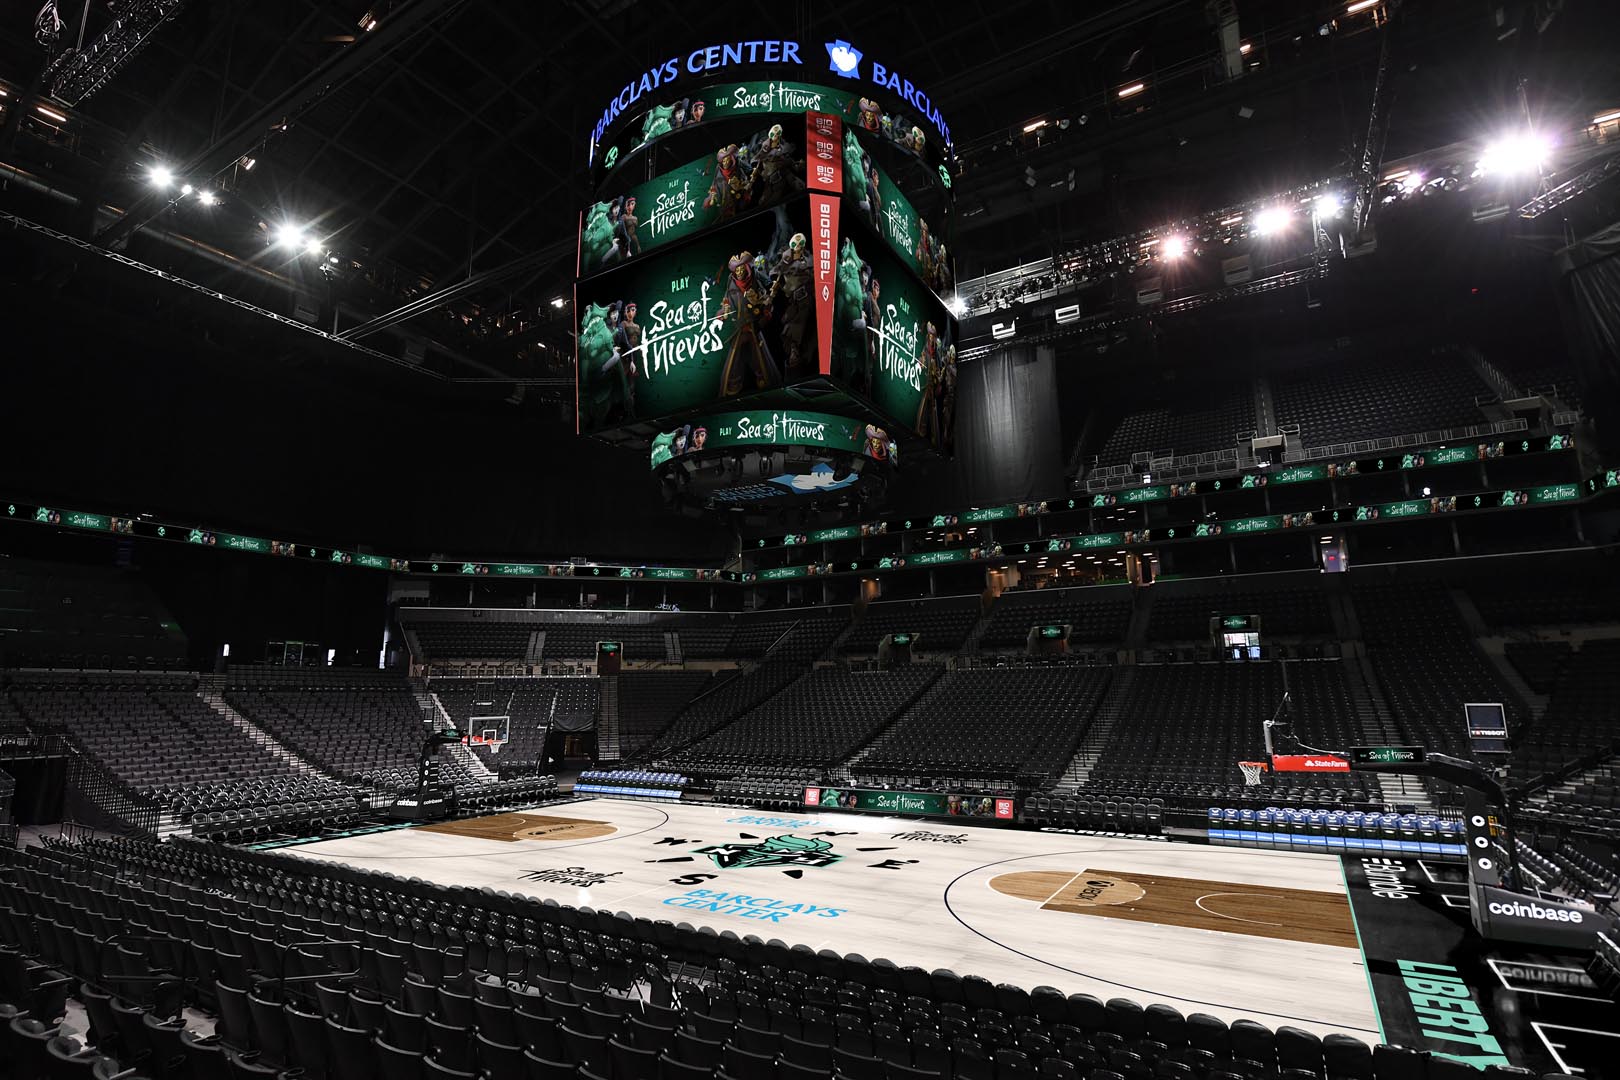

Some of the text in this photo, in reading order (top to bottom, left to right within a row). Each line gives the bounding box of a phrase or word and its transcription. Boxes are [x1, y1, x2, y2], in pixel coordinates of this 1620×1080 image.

[595, 40, 803, 142] BARCLAYS CENTER
[733, 87, 757, 109] Sea
[872, 62, 950, 145] BARCLAYS
[656, 193, 675, 213] Sea
[820, 203, 831, 280] BIOSTEEL
[671, 276, 689, 292] PLAY
[649, 281, 712, 334] Sea of
[885, 304, 905, 341] Sea
[719, 427, 732, 436] PLAY
[737, 417, 761, 439] Sea
[1314, 760, 1348, 768] State Farm
[877, 795, 890, 808] Sea
[662, 897, 792, 923] CENTER
[684, 889, 848, 919] BARCLAYS
[1488, 900, 1583, 924] coinbase
